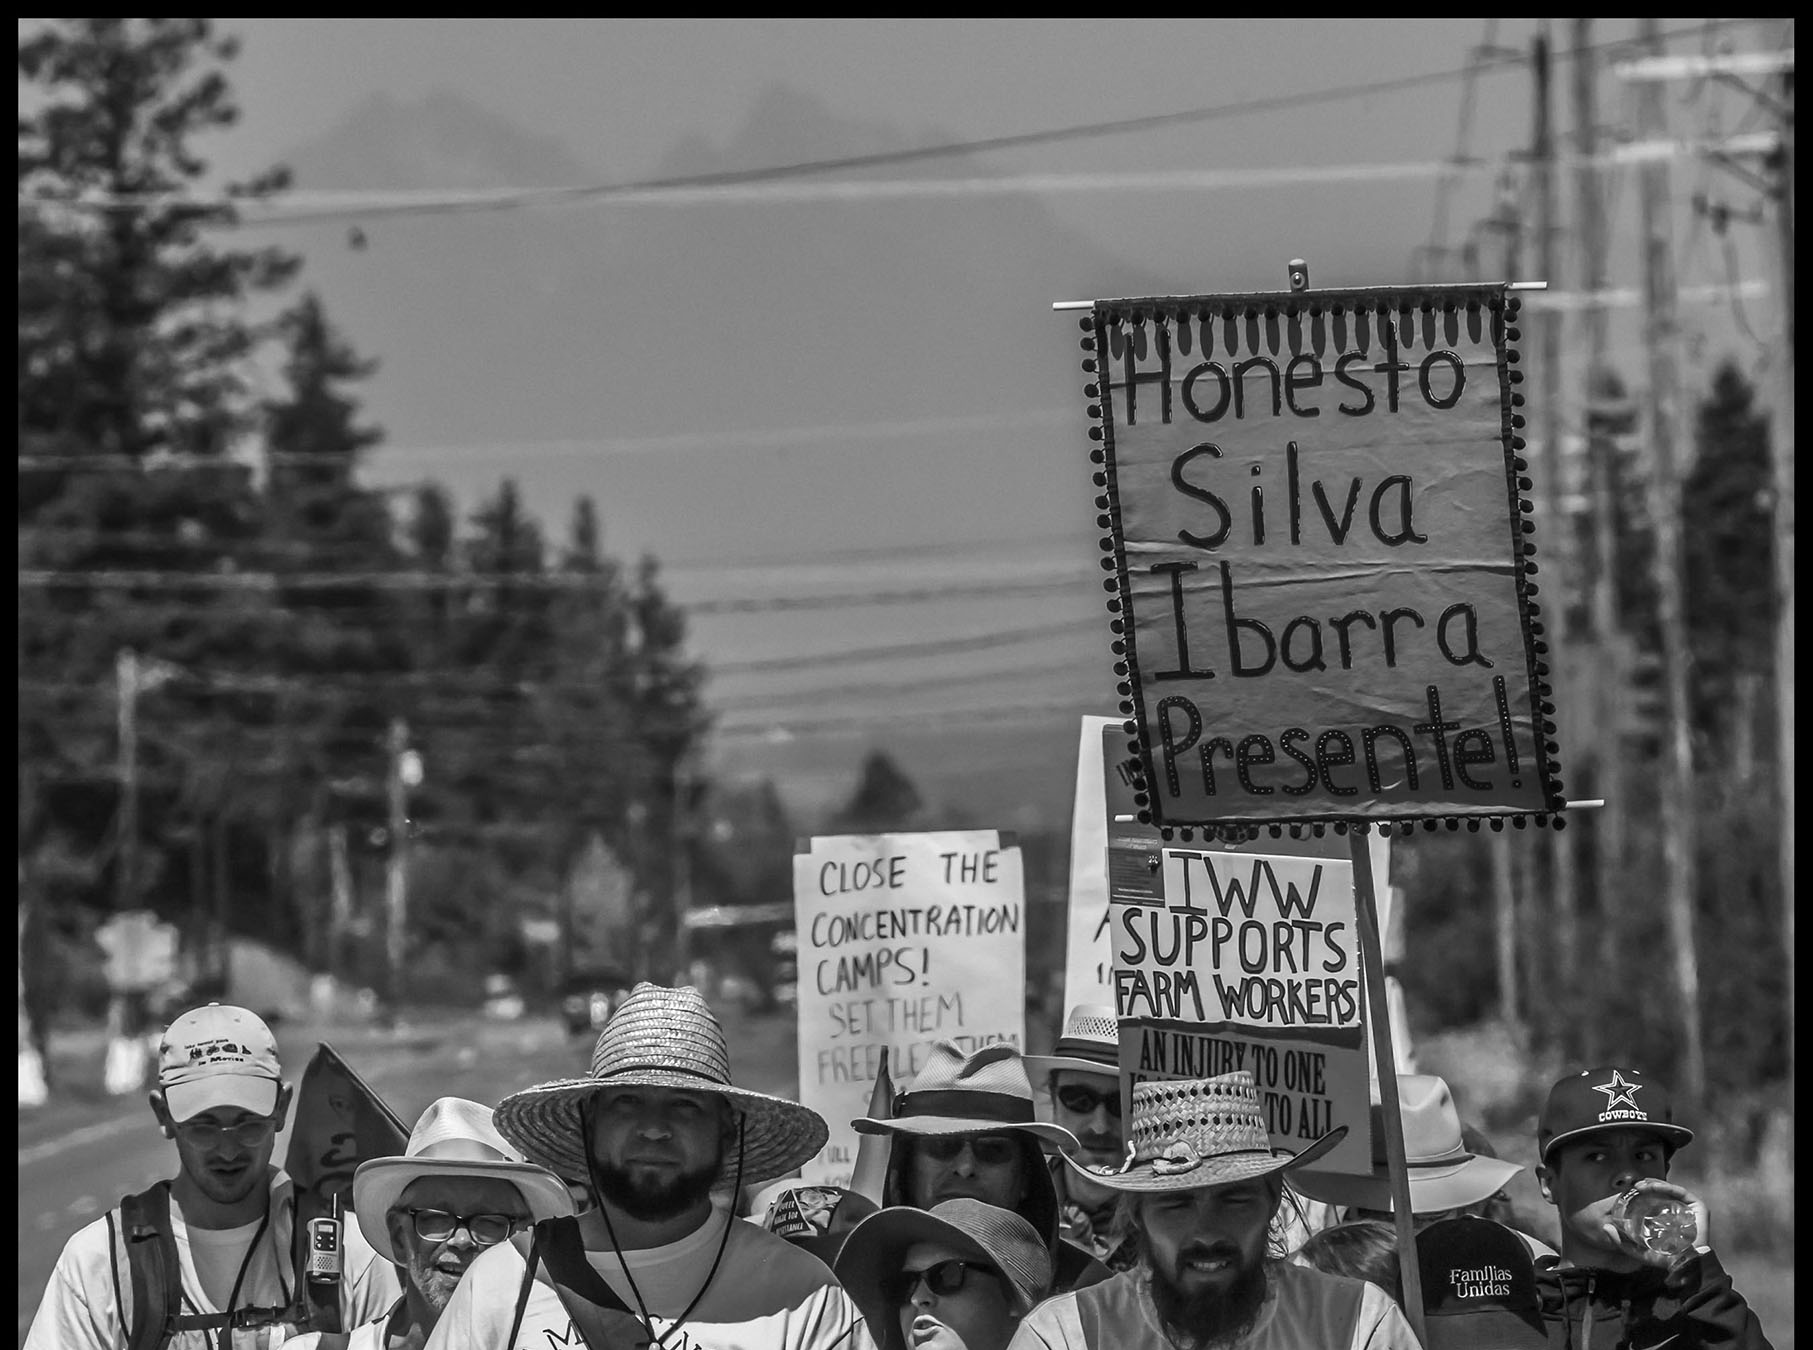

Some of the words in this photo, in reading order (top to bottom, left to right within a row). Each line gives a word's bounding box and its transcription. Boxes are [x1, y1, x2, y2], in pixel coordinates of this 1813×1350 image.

[1123, 320, 1466, 425] Honesto
[1170, 441, 1428, 549] Silva
[1150, 560, 1494, 680] Ibarra
[1156, 675, 1521, 797] Presente!
[819, 856, 907, 896] CLOSE
[939, 850, 999, 885] THE
[1169, 850, 1323, 919] IWW
[810, 902, 1019, 949] CONCENTRATION
[1120, 907, 1347, 973] SUPPORTS
[816, 947, 930, 996] CAMPS!
[1114, 969, 1206, 1021] FARM
[1212, 973, 1358, 1026] WORKERS
[885, 991, 965, 1033] THEM
[1139, 1028, 1167, 1072] AN
[1172, 1033, 1247, 1078] INJURY
[1251, 1044, 1279, 1088] TO
[1283, 1049, 1327, 1095] ONE
[1265, 1092, 1292, 1135] TO
[1598, 1109, 1648, 1123] COWBOYS
[1449, 1265, 1513, 1285] Familias
[1456, 1282, 1510, 1299] Unidas
